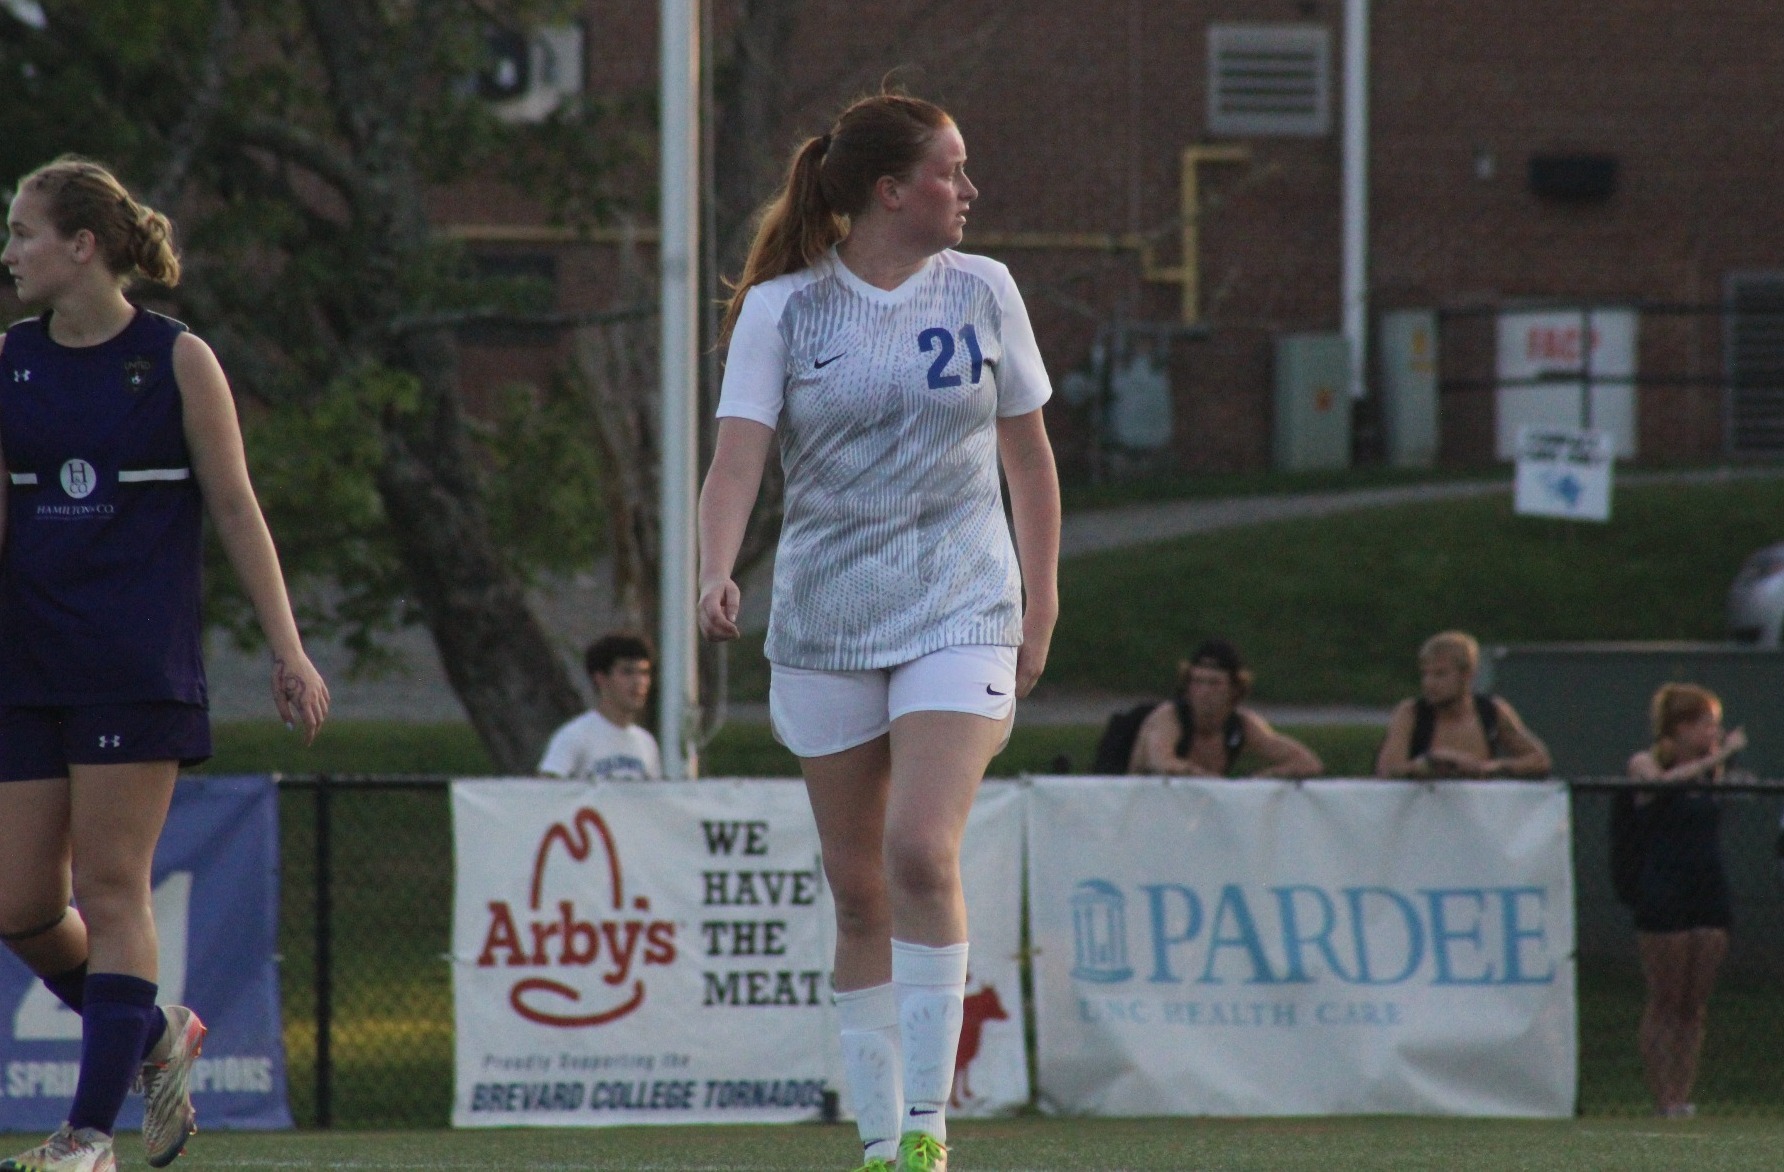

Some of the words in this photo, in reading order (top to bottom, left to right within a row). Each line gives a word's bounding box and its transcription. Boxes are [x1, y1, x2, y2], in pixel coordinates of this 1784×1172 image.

[918, 323, 983, 389] 21
[702, 820, 769, 857] WE
[702, 870, 816, 906] HAVE
[477, 896, 676, 985] Arby's
[702, 920, 787, 957] THE
[1139, 883, 1557, 987] PARDEE
[702, 970, 836, 1007] MEAT
[471, 1080, 585, 1112] BREVARD
[590, 1079, 698, 1110] COLLEGE
